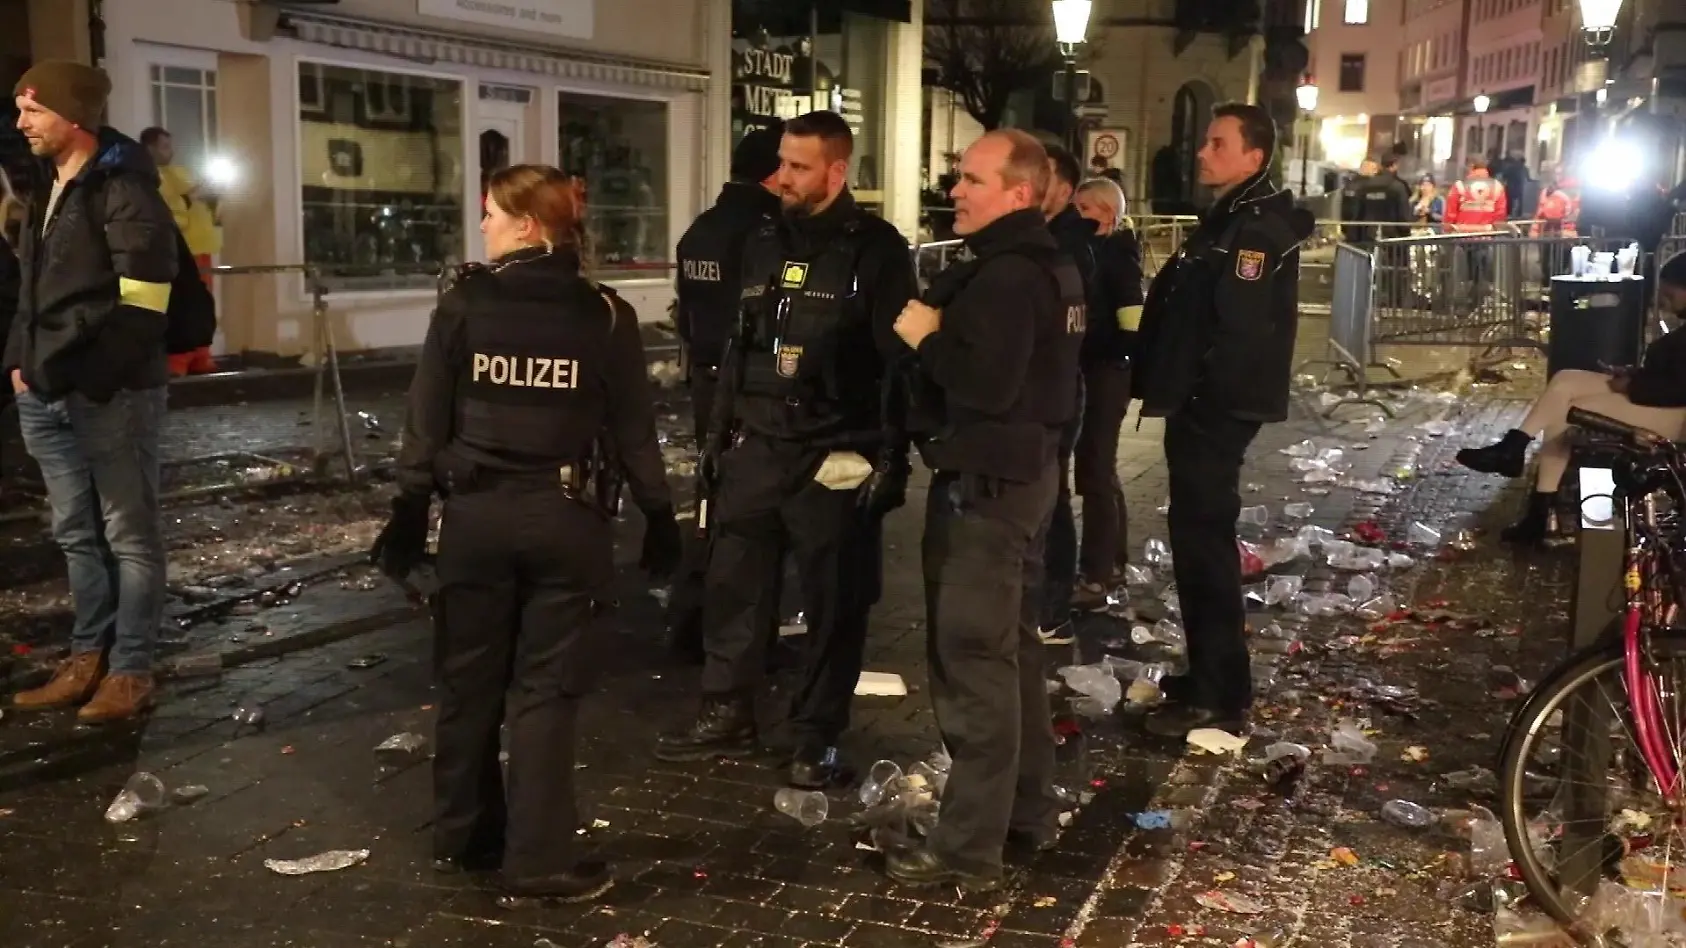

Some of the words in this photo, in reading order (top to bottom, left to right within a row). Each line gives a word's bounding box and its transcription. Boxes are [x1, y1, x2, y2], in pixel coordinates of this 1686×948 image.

[744, 49, 793, 80] STADT
[1101, 141, 1114, 154] 20
[683, 259, 720, 281] POLIZEI
[473, 352, 579, 389] POLIZEI
